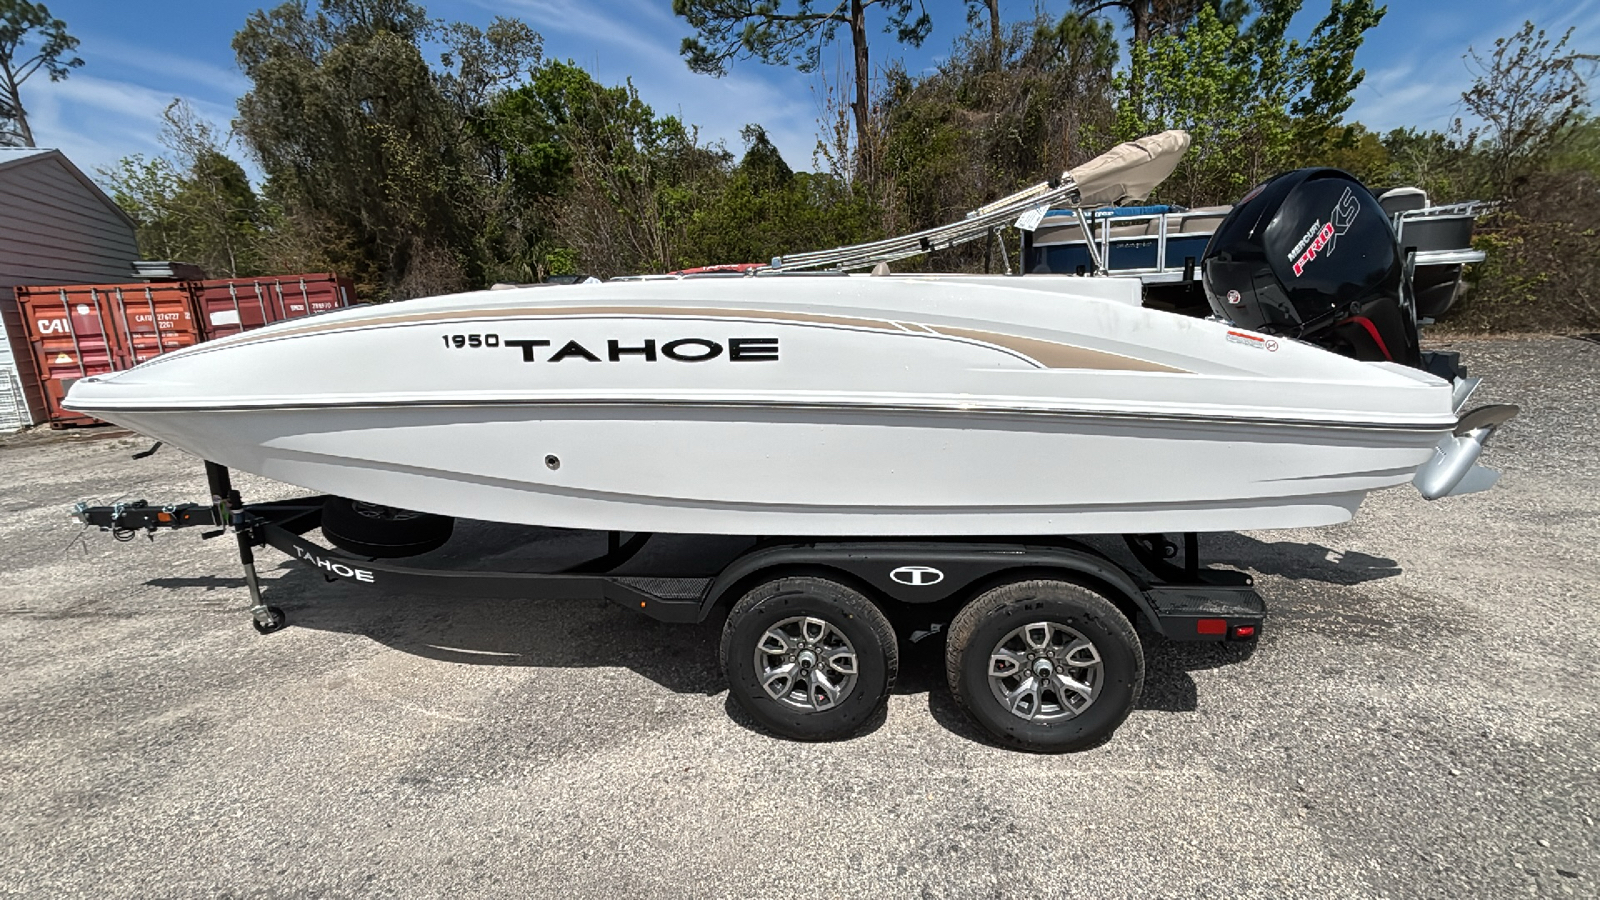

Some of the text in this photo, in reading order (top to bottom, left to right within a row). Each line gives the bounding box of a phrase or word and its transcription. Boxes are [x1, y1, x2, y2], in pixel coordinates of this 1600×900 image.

[1287, 219, 1320, 263] MERCURY
[1292, 222, 1335, 277] PRO
[442, 333, 779, 362] 1950 TAHOE
[293, 544, 375, 583] TAHOE
